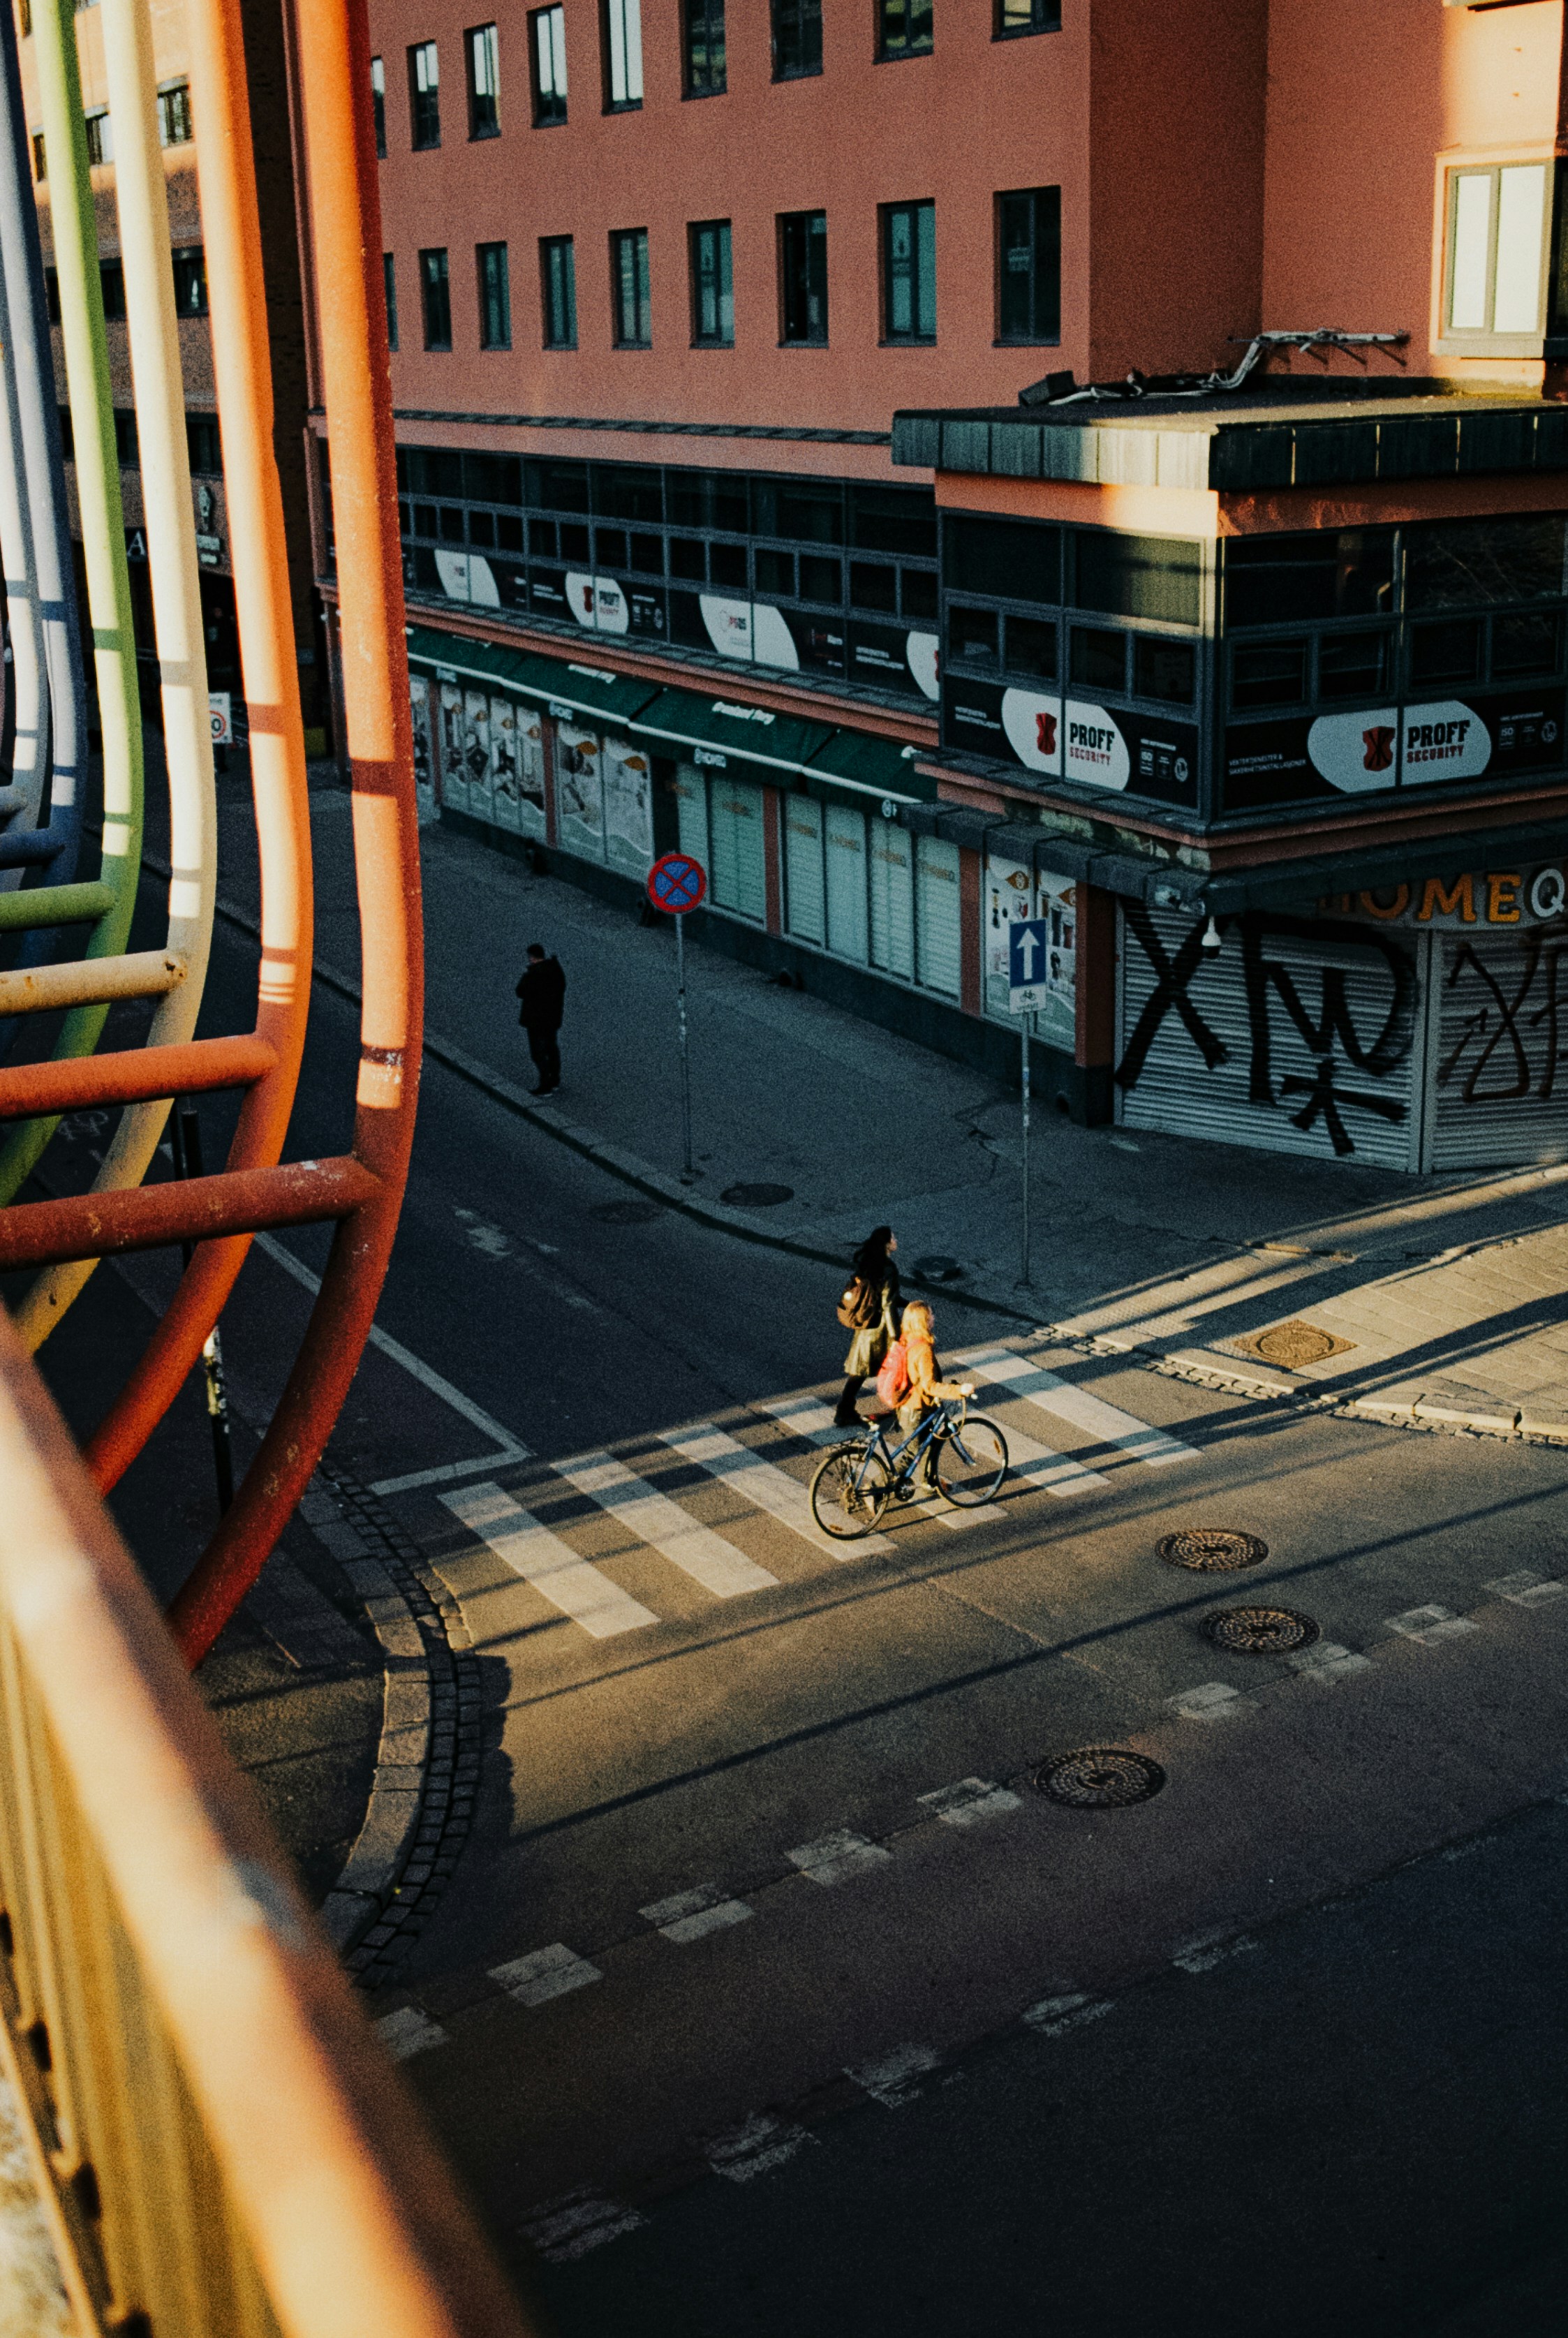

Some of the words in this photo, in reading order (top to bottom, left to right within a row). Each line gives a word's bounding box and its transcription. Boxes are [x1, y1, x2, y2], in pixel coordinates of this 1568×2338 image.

[1070, 723, 1115, 752] PROFF
[1407, 719, 1470, 748] PROFF
[1070, 746, 1111, 766] SECURITY
[1407, 744, 1464, 763] SECURITY
